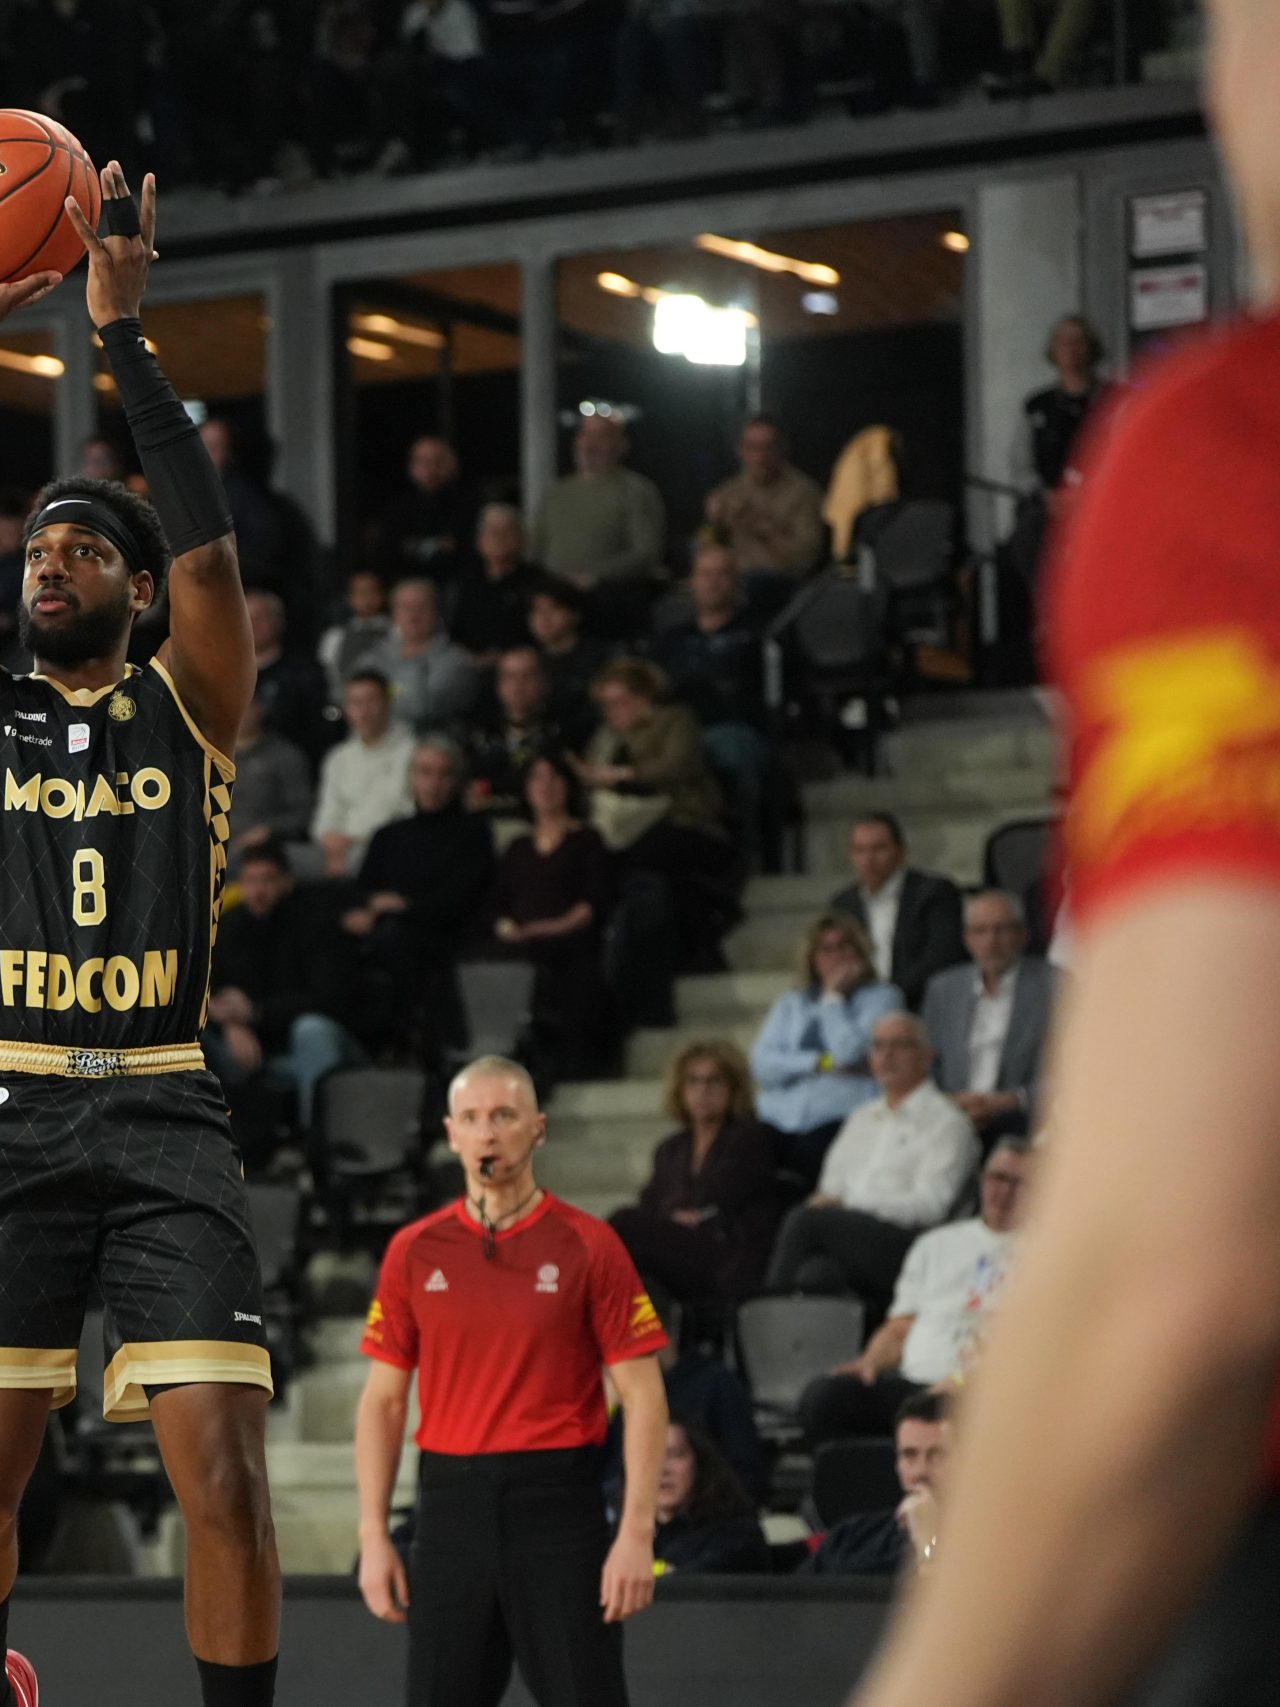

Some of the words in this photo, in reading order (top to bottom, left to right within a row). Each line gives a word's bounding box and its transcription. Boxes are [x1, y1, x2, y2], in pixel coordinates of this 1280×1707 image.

[14, 710, 47, 723] PALDING
[72, 847, 107, 926] 8
[0, 949, 178, 1013] FEDCOM
[76, 1053, 117, 1067] Roca
